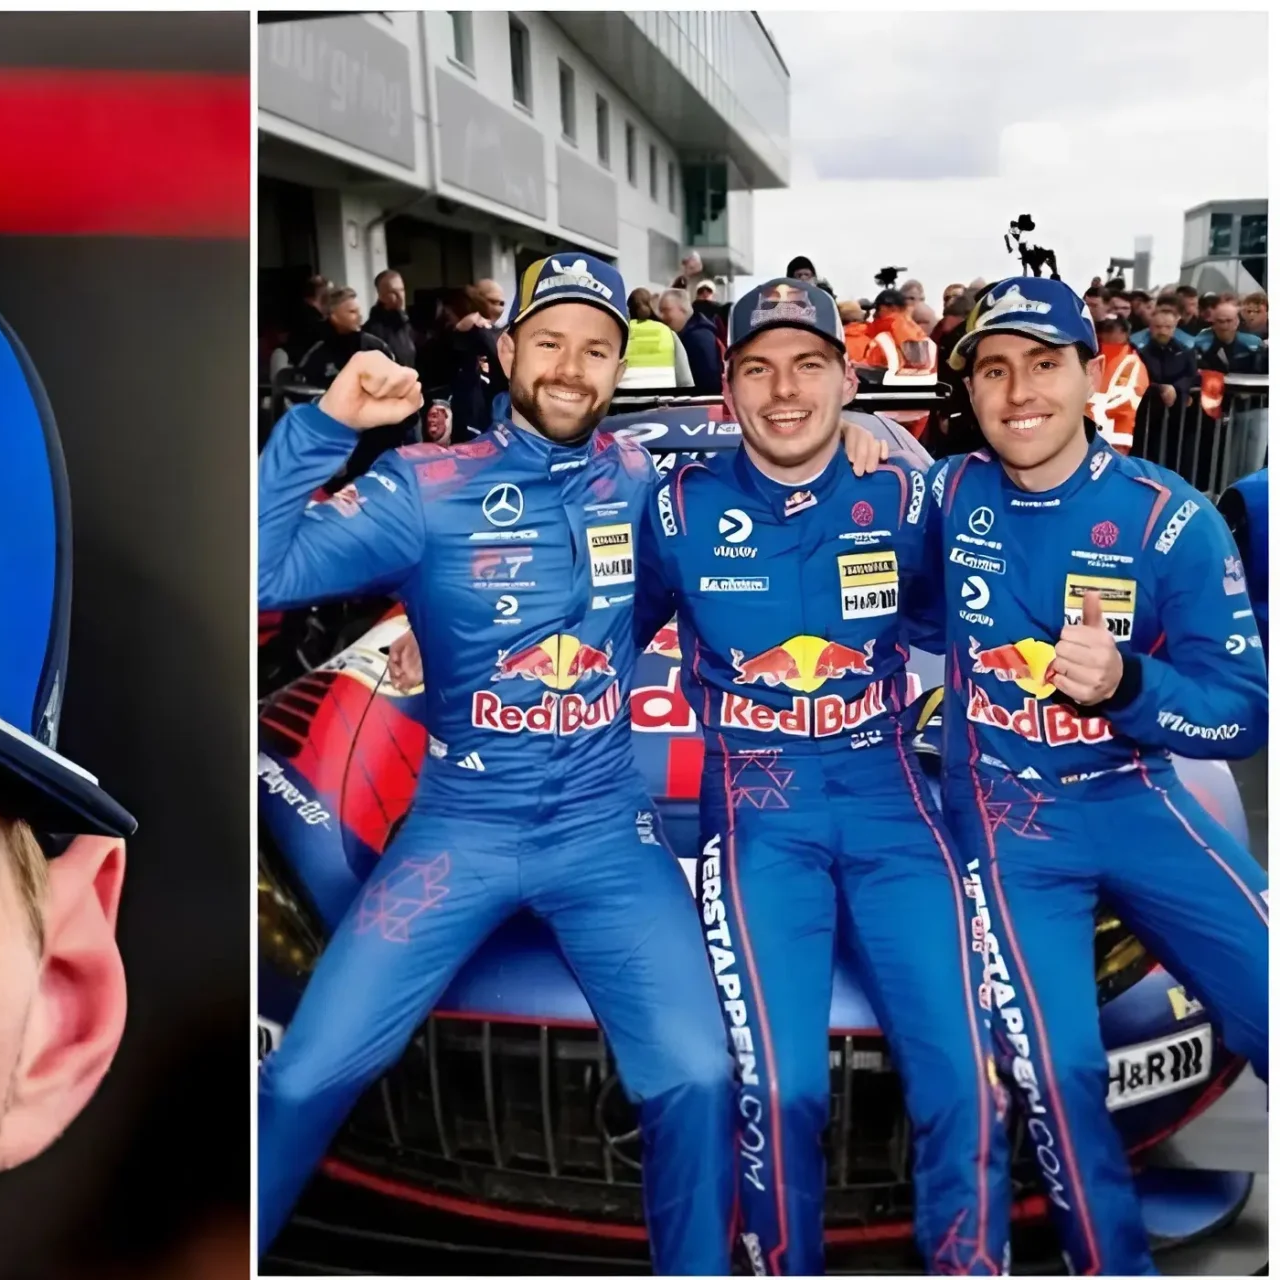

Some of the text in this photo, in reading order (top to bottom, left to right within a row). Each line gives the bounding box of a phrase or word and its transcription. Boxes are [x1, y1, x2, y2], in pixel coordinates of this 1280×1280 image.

[472, 679, 621, 737] Red Bull
[720, 679, 887, 738] Red Bull
